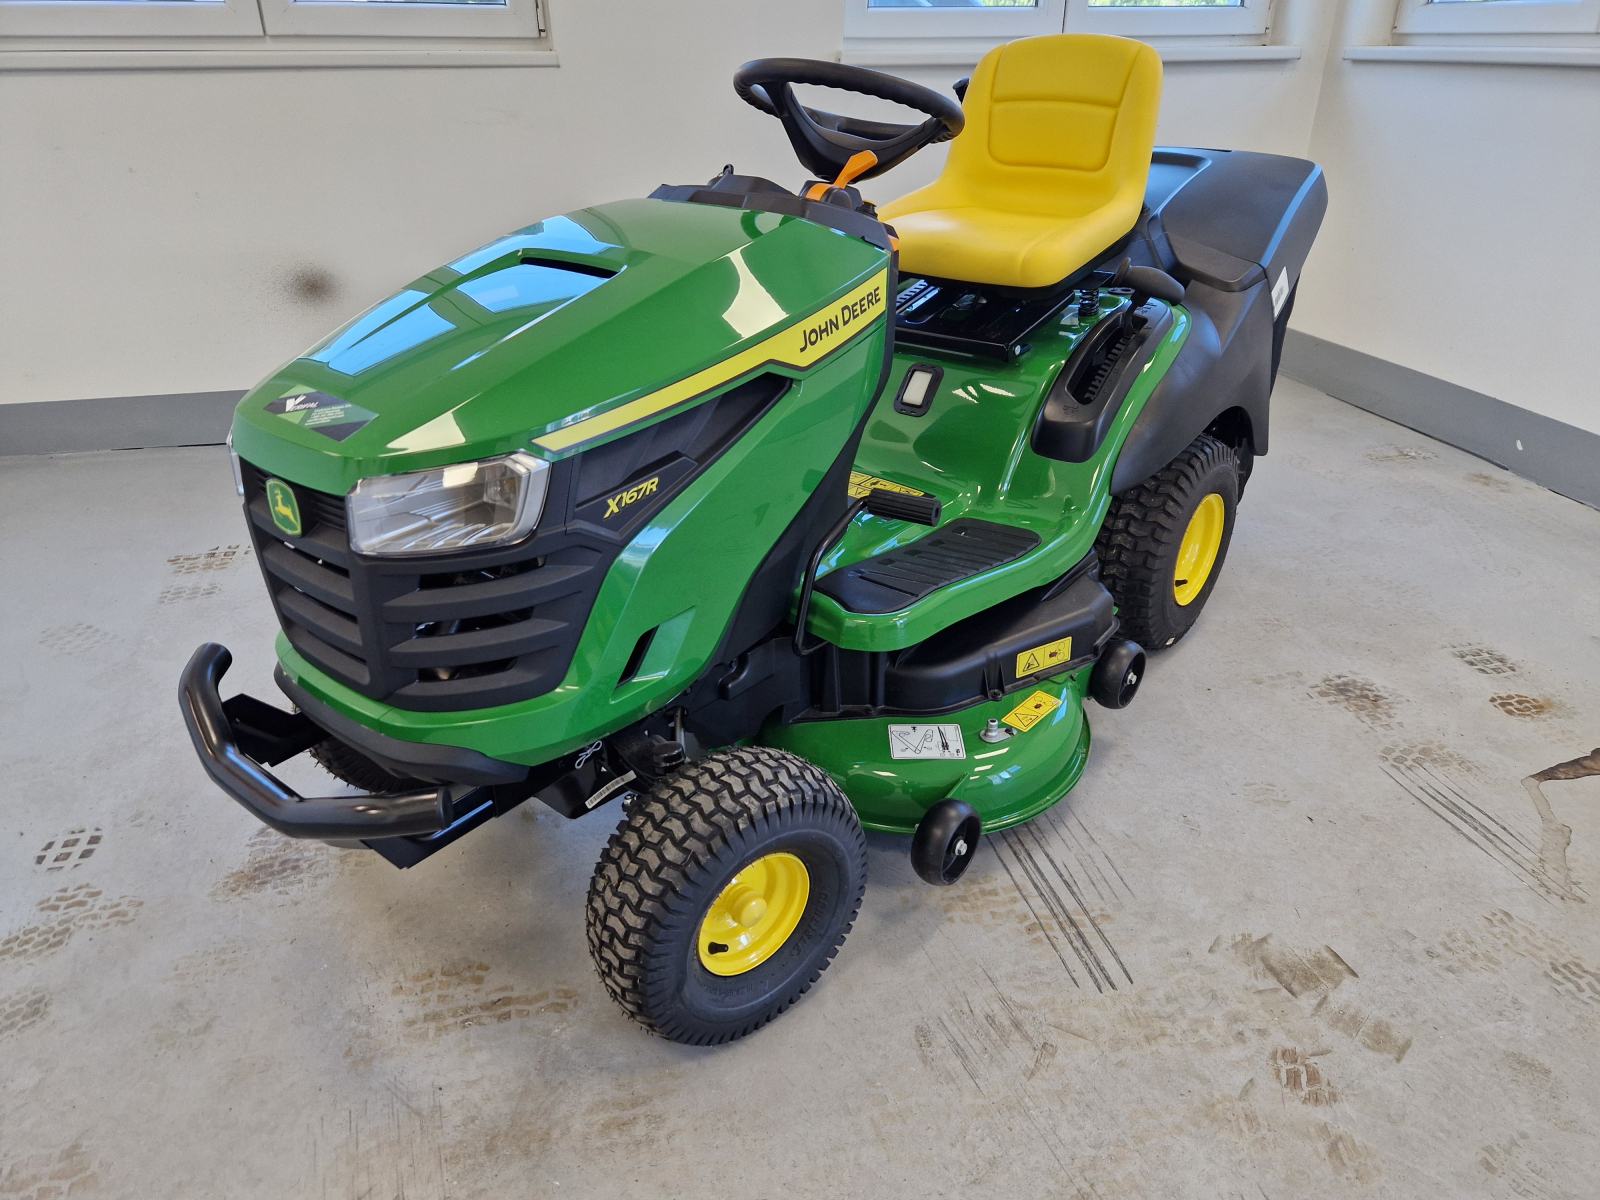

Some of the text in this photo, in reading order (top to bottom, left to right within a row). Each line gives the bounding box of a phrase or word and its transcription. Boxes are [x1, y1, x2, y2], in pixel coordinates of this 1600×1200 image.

[800, 286, 881, 353] JOHN DEERE
[603, 477, 659, 519] X167R
